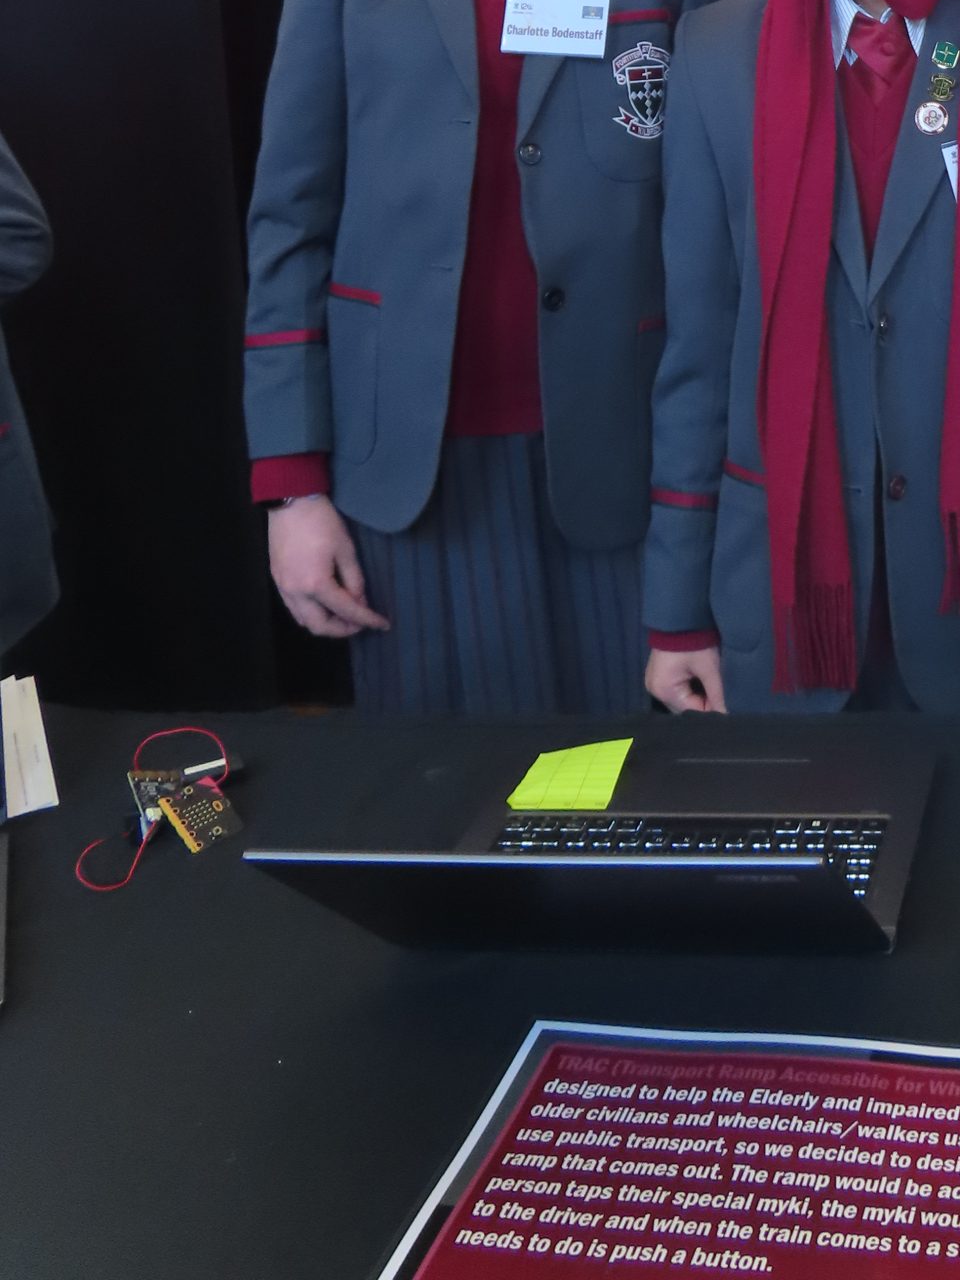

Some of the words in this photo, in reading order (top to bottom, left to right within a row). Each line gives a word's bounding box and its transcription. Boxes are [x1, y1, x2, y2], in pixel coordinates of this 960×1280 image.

[506, 24, 550, 37] Charlotte
[552, 26, 603, 40] Bodenstaff
[556, 1055, 609, 1073] TRAC
[612, 1058, 715, 1079] (Transport
[718, 1064, 778, 1084] Ramp
[780, 1065, 891, 1091] Accessible
[895, 1076, 924, 1095] for
[543, 1078, 635, 1101] designed
[638, 1084, 660, 1101] to
[662, 1084, 707, 1105] help
[711, 1087, 745, 1105] the
[748, 1088, 819, 1111] Elderly
[822, 1094, 863, 1113] and
[530, 1102, 585, 1121] older
[585, 1106, 669, 1126] civilians
[672, 1110, 714, 1128] and
[717, 1113, 940, 1145] wheelchairs/walkers
[516, 1127, 554, 1143] use
[556, 1130, 623, 1148] public
[626, 1133, 729, 1157] transport,
[734, 1140, 759, 1155] so
[764, 1142, 793, 1158] we
[798, 1142, 885, 1166] decided
[889, 1151, 911, 1168] to
[501, 1152, 558, 1171] ramp
[561, 1154, 607, 1173] that
[608, 1160, 680, 1178] comes
[683, 1163, 724, 1181] out.
[731, 1164, 769, 1183] The
[773, 1169, 830, 1191] ramp
[835, 1176, 901, 1195] would
[905, 1179, 933, 1197] be
